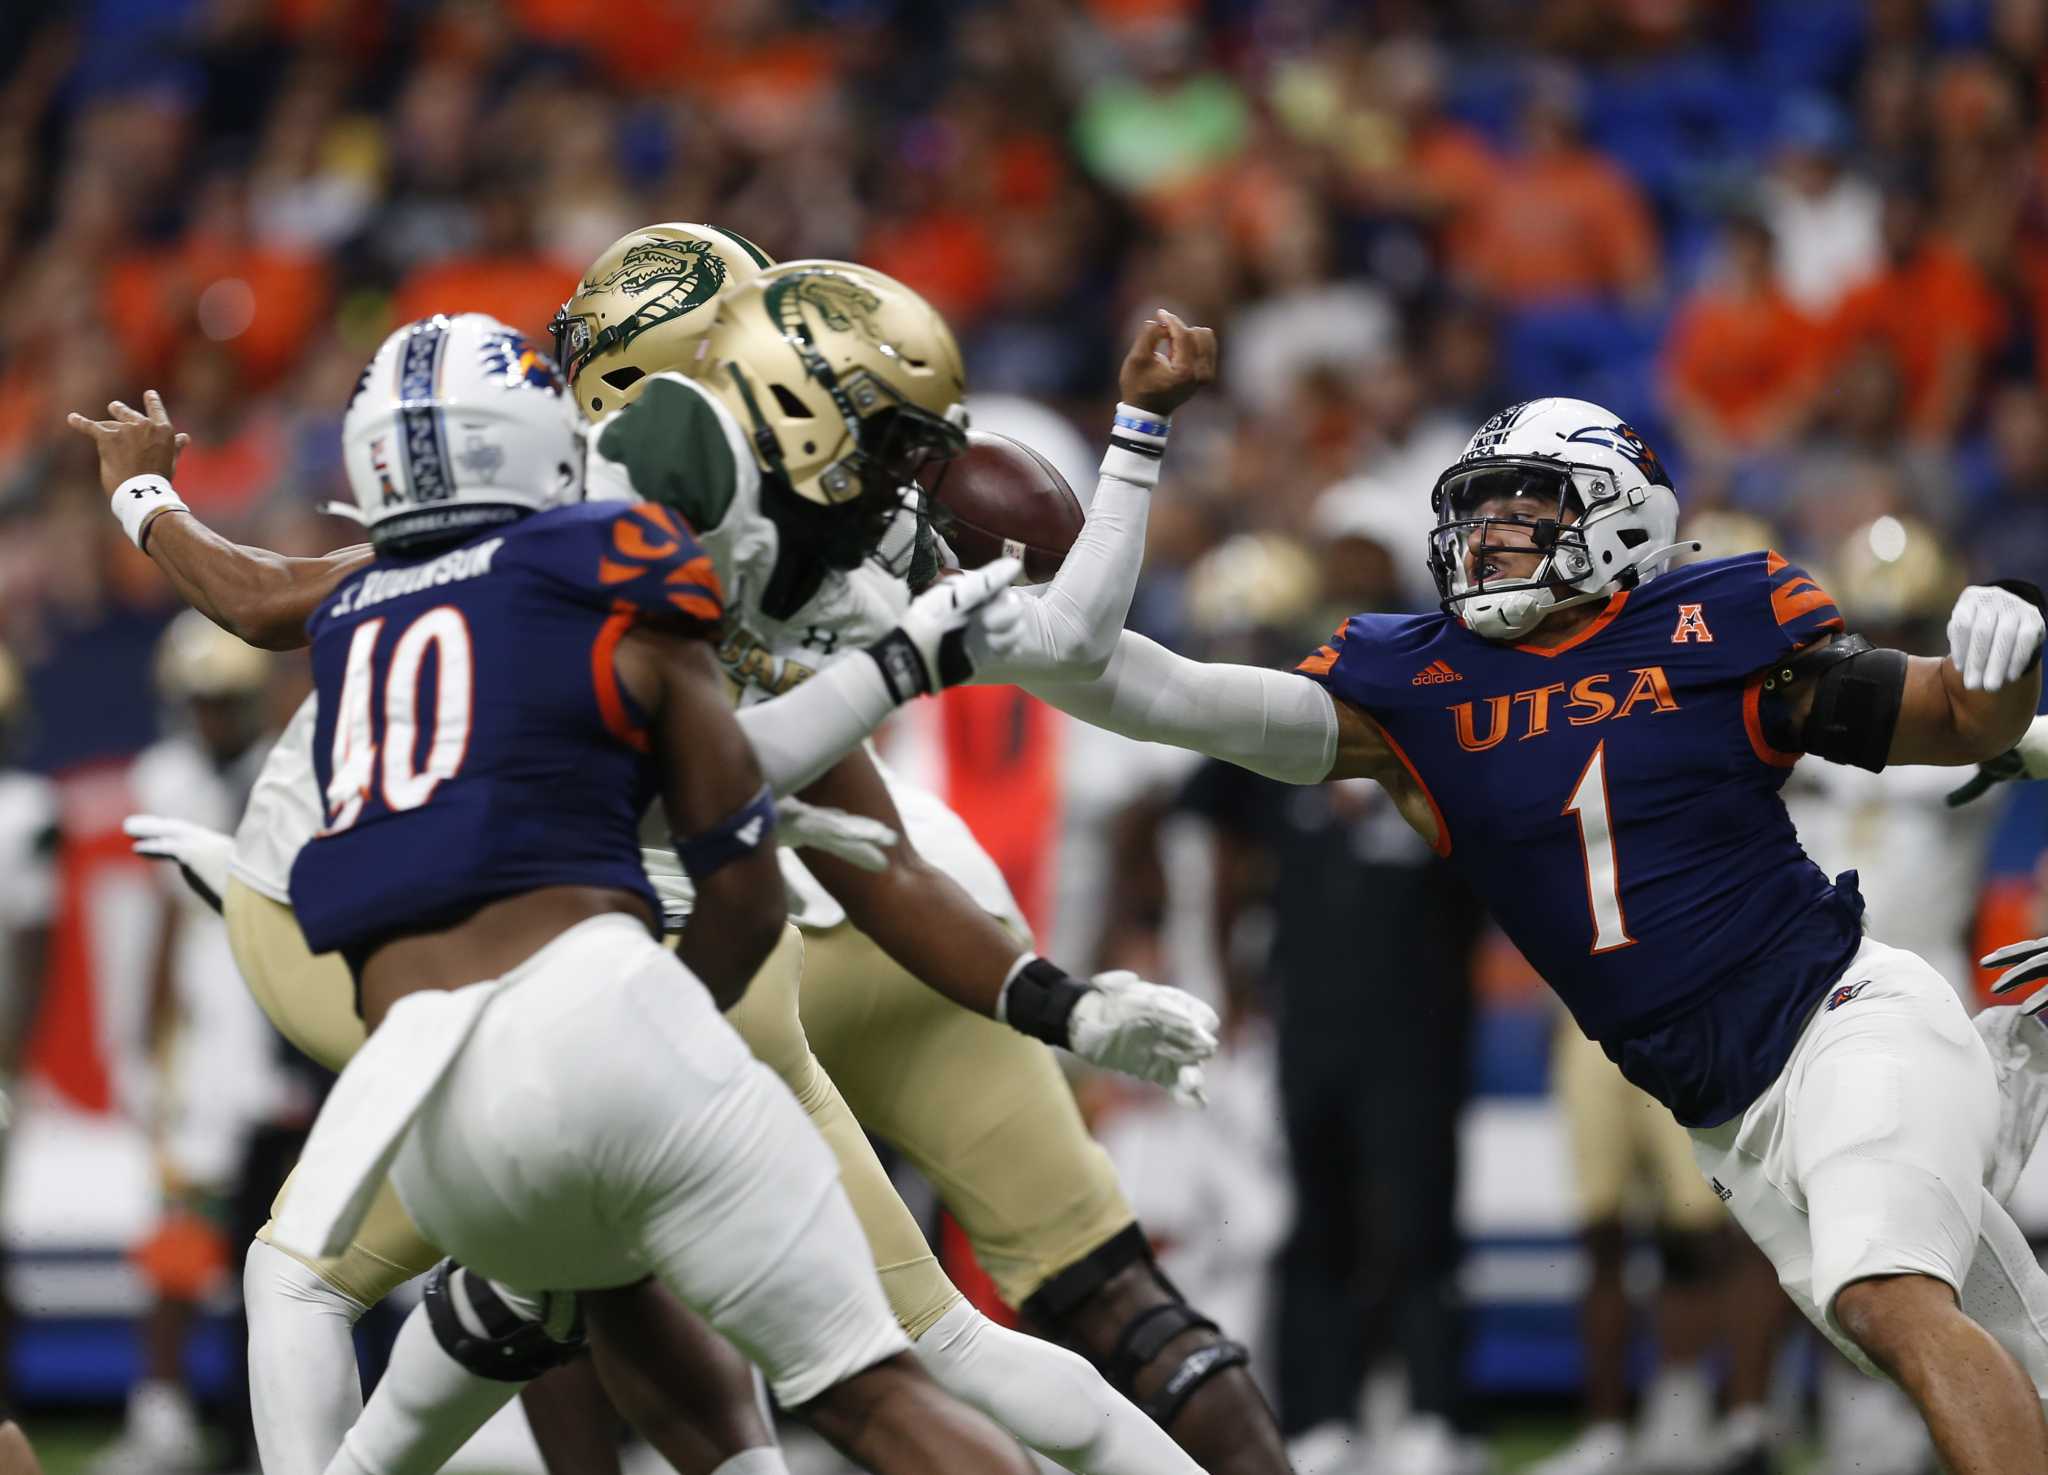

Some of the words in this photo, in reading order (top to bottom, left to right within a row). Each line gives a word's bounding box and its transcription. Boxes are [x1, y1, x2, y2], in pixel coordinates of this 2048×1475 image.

[1671, 603, 1713, 643] A
[1411, 671, 1464, 686] adidas
[1446, 666, 1683, 752] UTSA
[1560, 738, 1639, 955] 1
